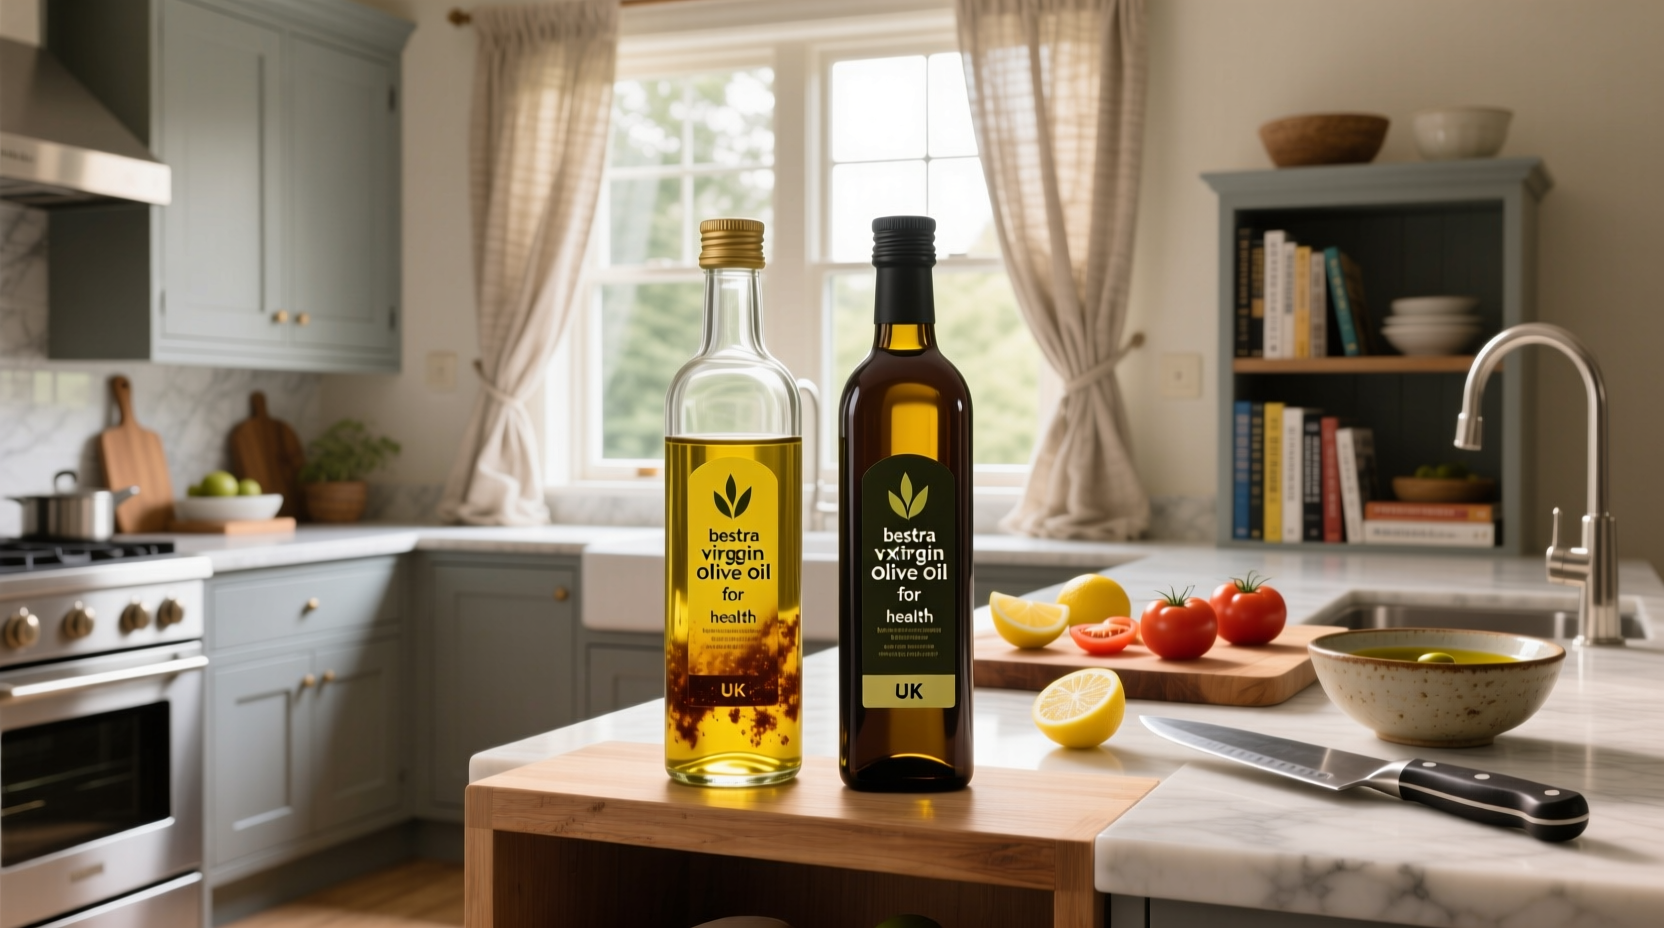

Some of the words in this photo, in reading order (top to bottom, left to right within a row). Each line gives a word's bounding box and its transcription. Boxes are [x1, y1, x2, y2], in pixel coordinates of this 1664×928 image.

[709, 528, 759, 542] bestra
[883, 527, 936, 543] bestra
[722, 586, 744, 601] for
[897, 586, 921, 601] for
[710, 609, 756, 623] health
[886, 607, 934, 623] health
[721, 682, 746, 698] UK
[895, 683, 923, 700] UK
